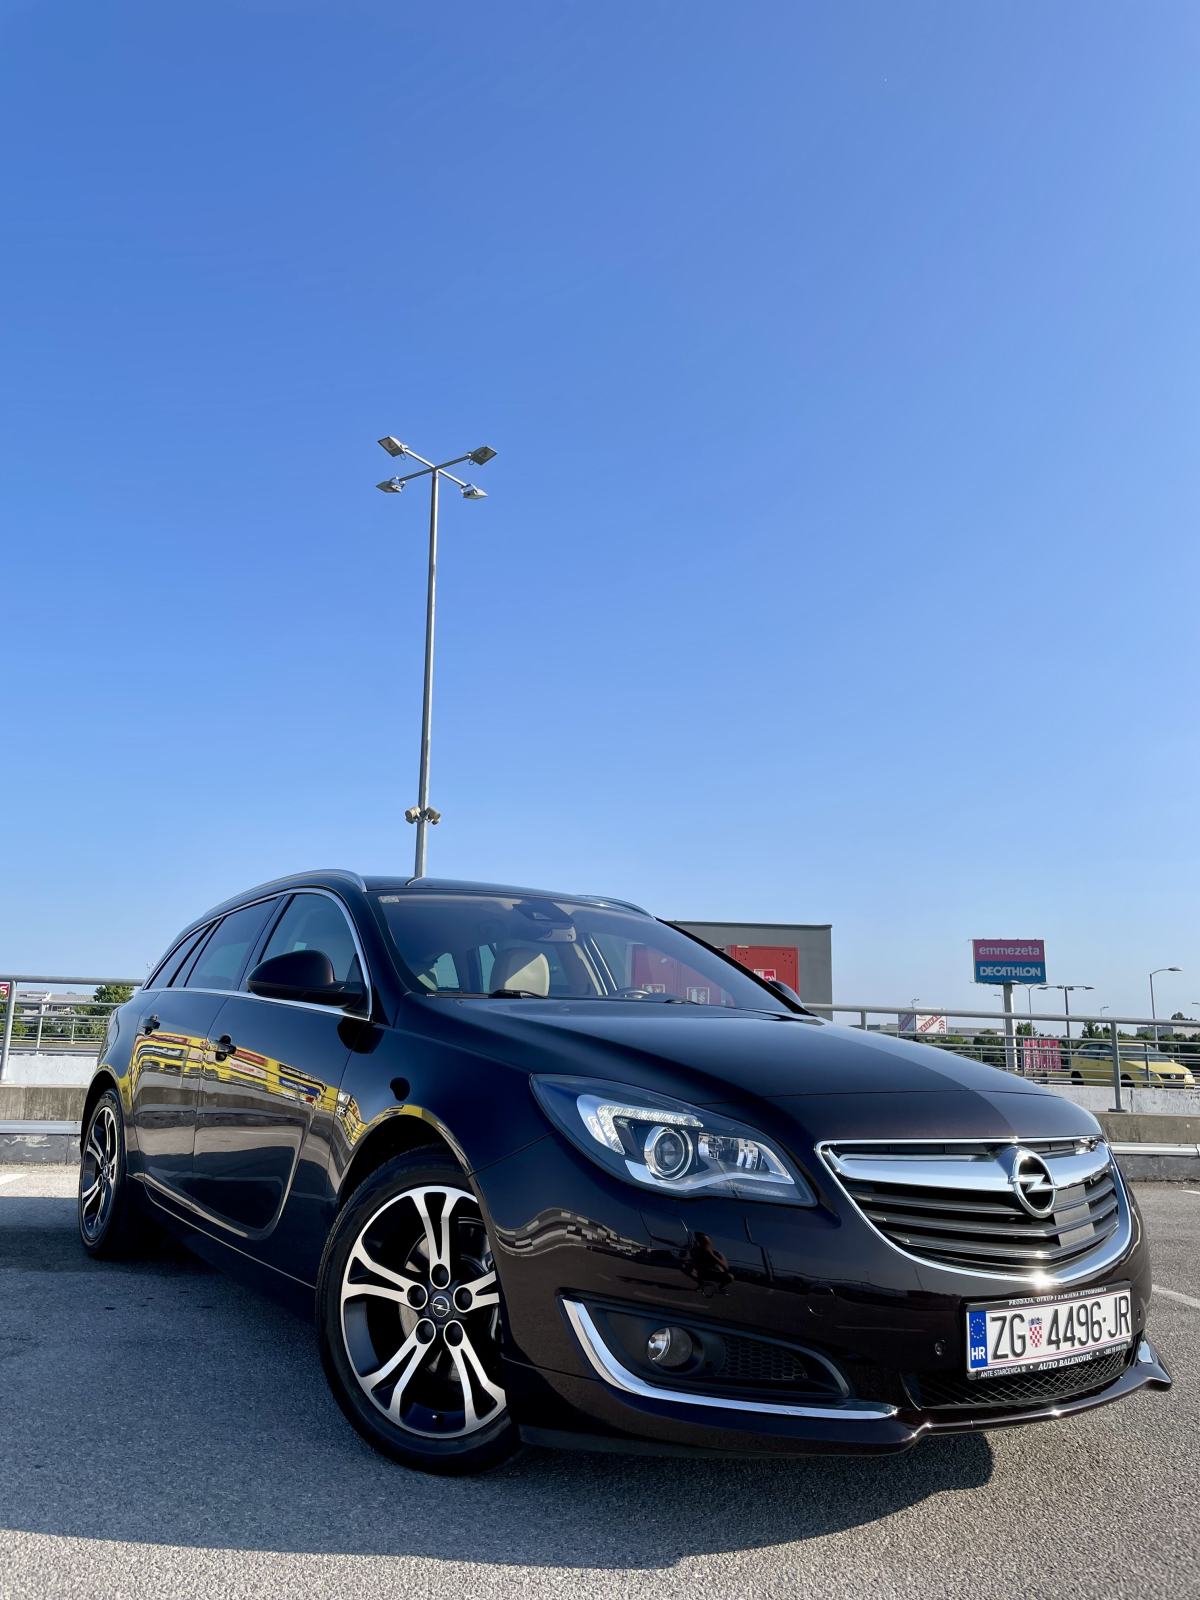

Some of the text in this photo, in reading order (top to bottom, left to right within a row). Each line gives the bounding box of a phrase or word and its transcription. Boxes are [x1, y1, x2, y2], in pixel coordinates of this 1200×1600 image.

[979, 945, 1040, 956] emmezeta
[979, 966, 1042, 977] DECATHLON
[989, 1313, 1027, 1360] ZG
[971, 1346, 986, 1361] HR
[1038, 1352, 1093, 1371] AUTO BALENOVIĆ
[981, 1370, 993, 1378] ANTE
